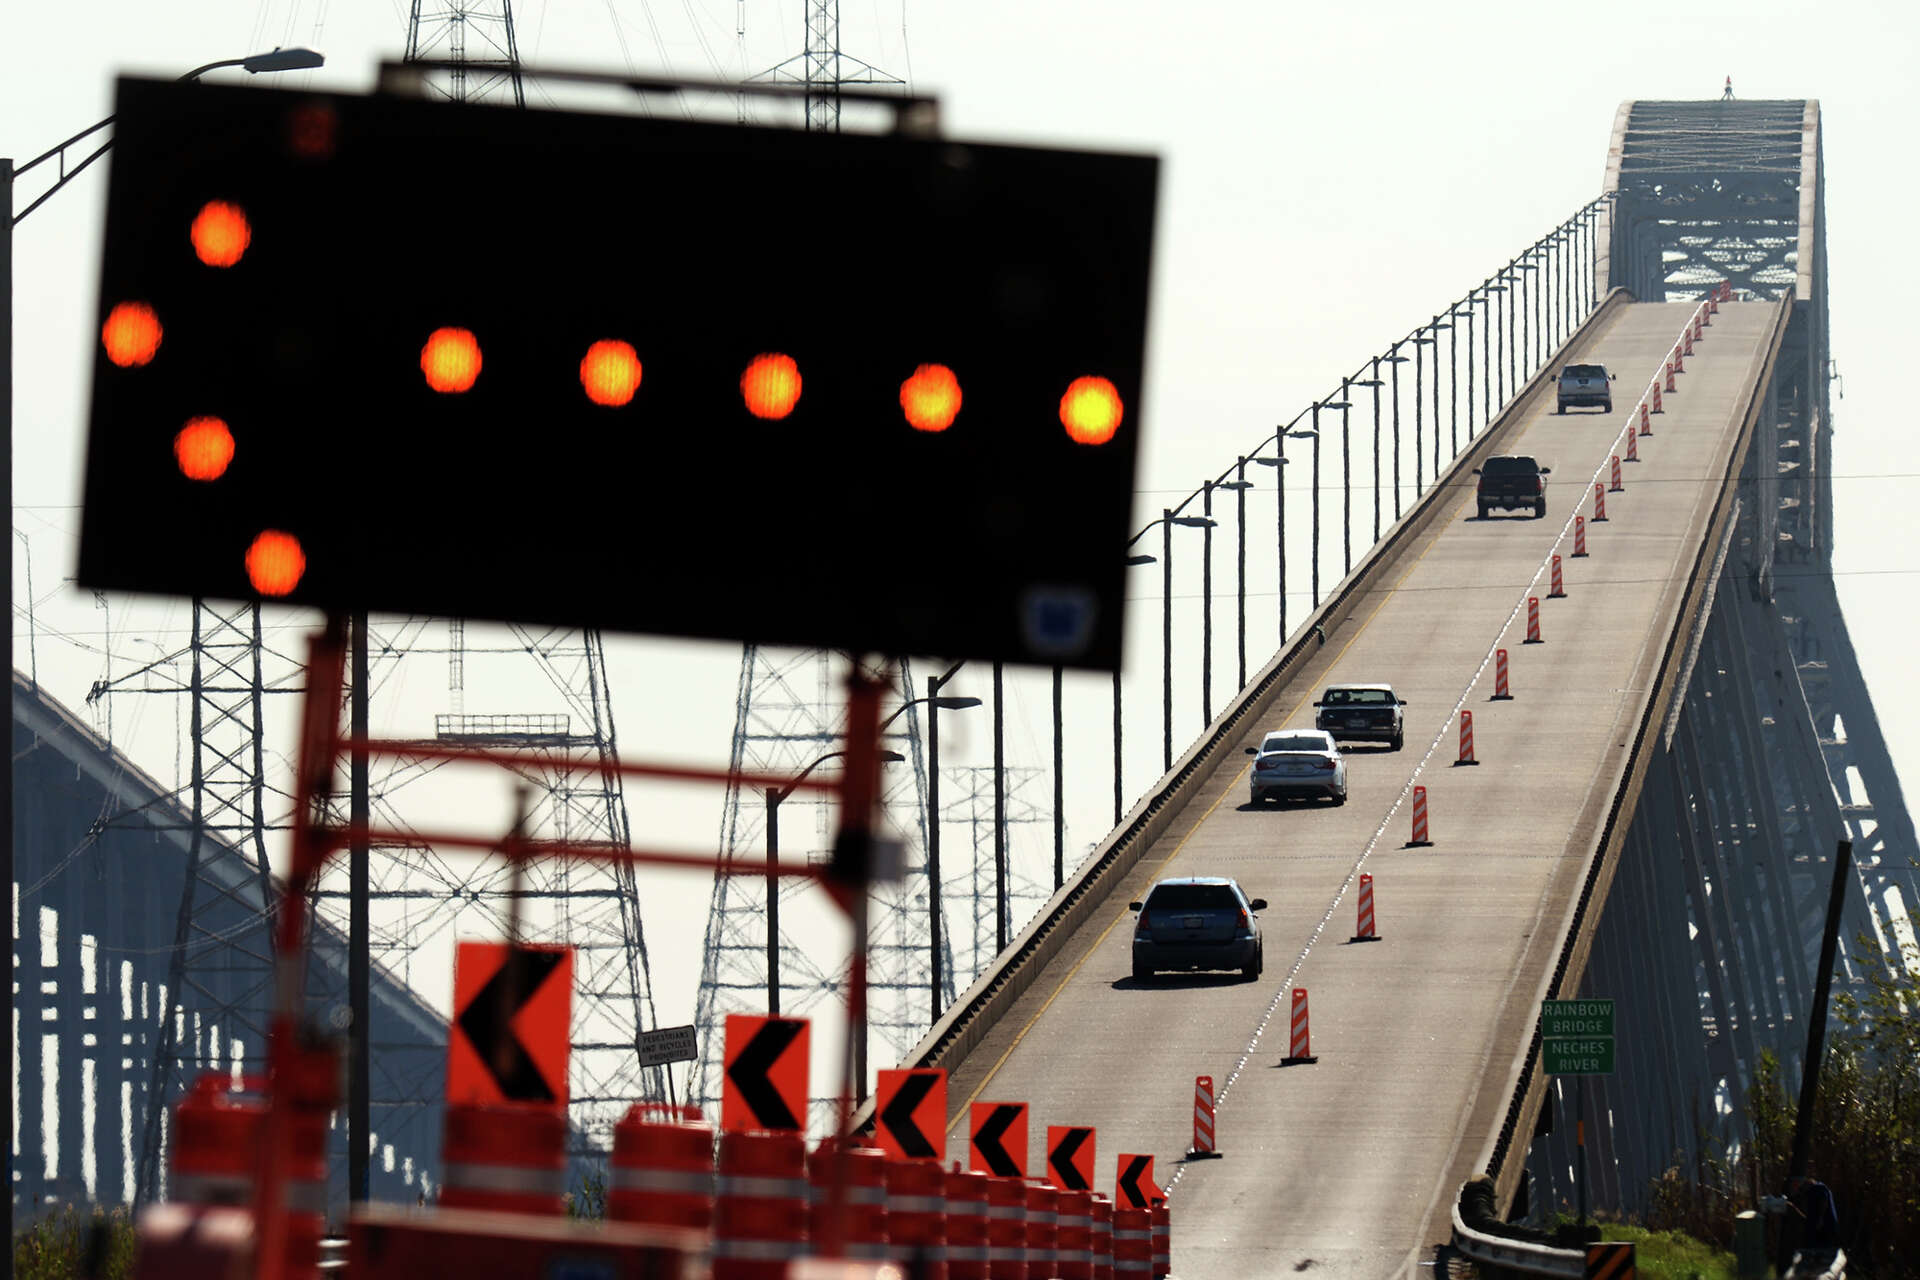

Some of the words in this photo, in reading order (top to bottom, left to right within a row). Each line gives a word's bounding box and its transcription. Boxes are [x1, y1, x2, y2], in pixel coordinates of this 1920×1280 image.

[1544, 1004, 1611, 1016] RAINBOW
[1553, 1020, 1604, 1032] BRIDGE
[1552, 1042, 1606, 1054] NECHES
[1560, 1058, 1600, 1071] RIVER
